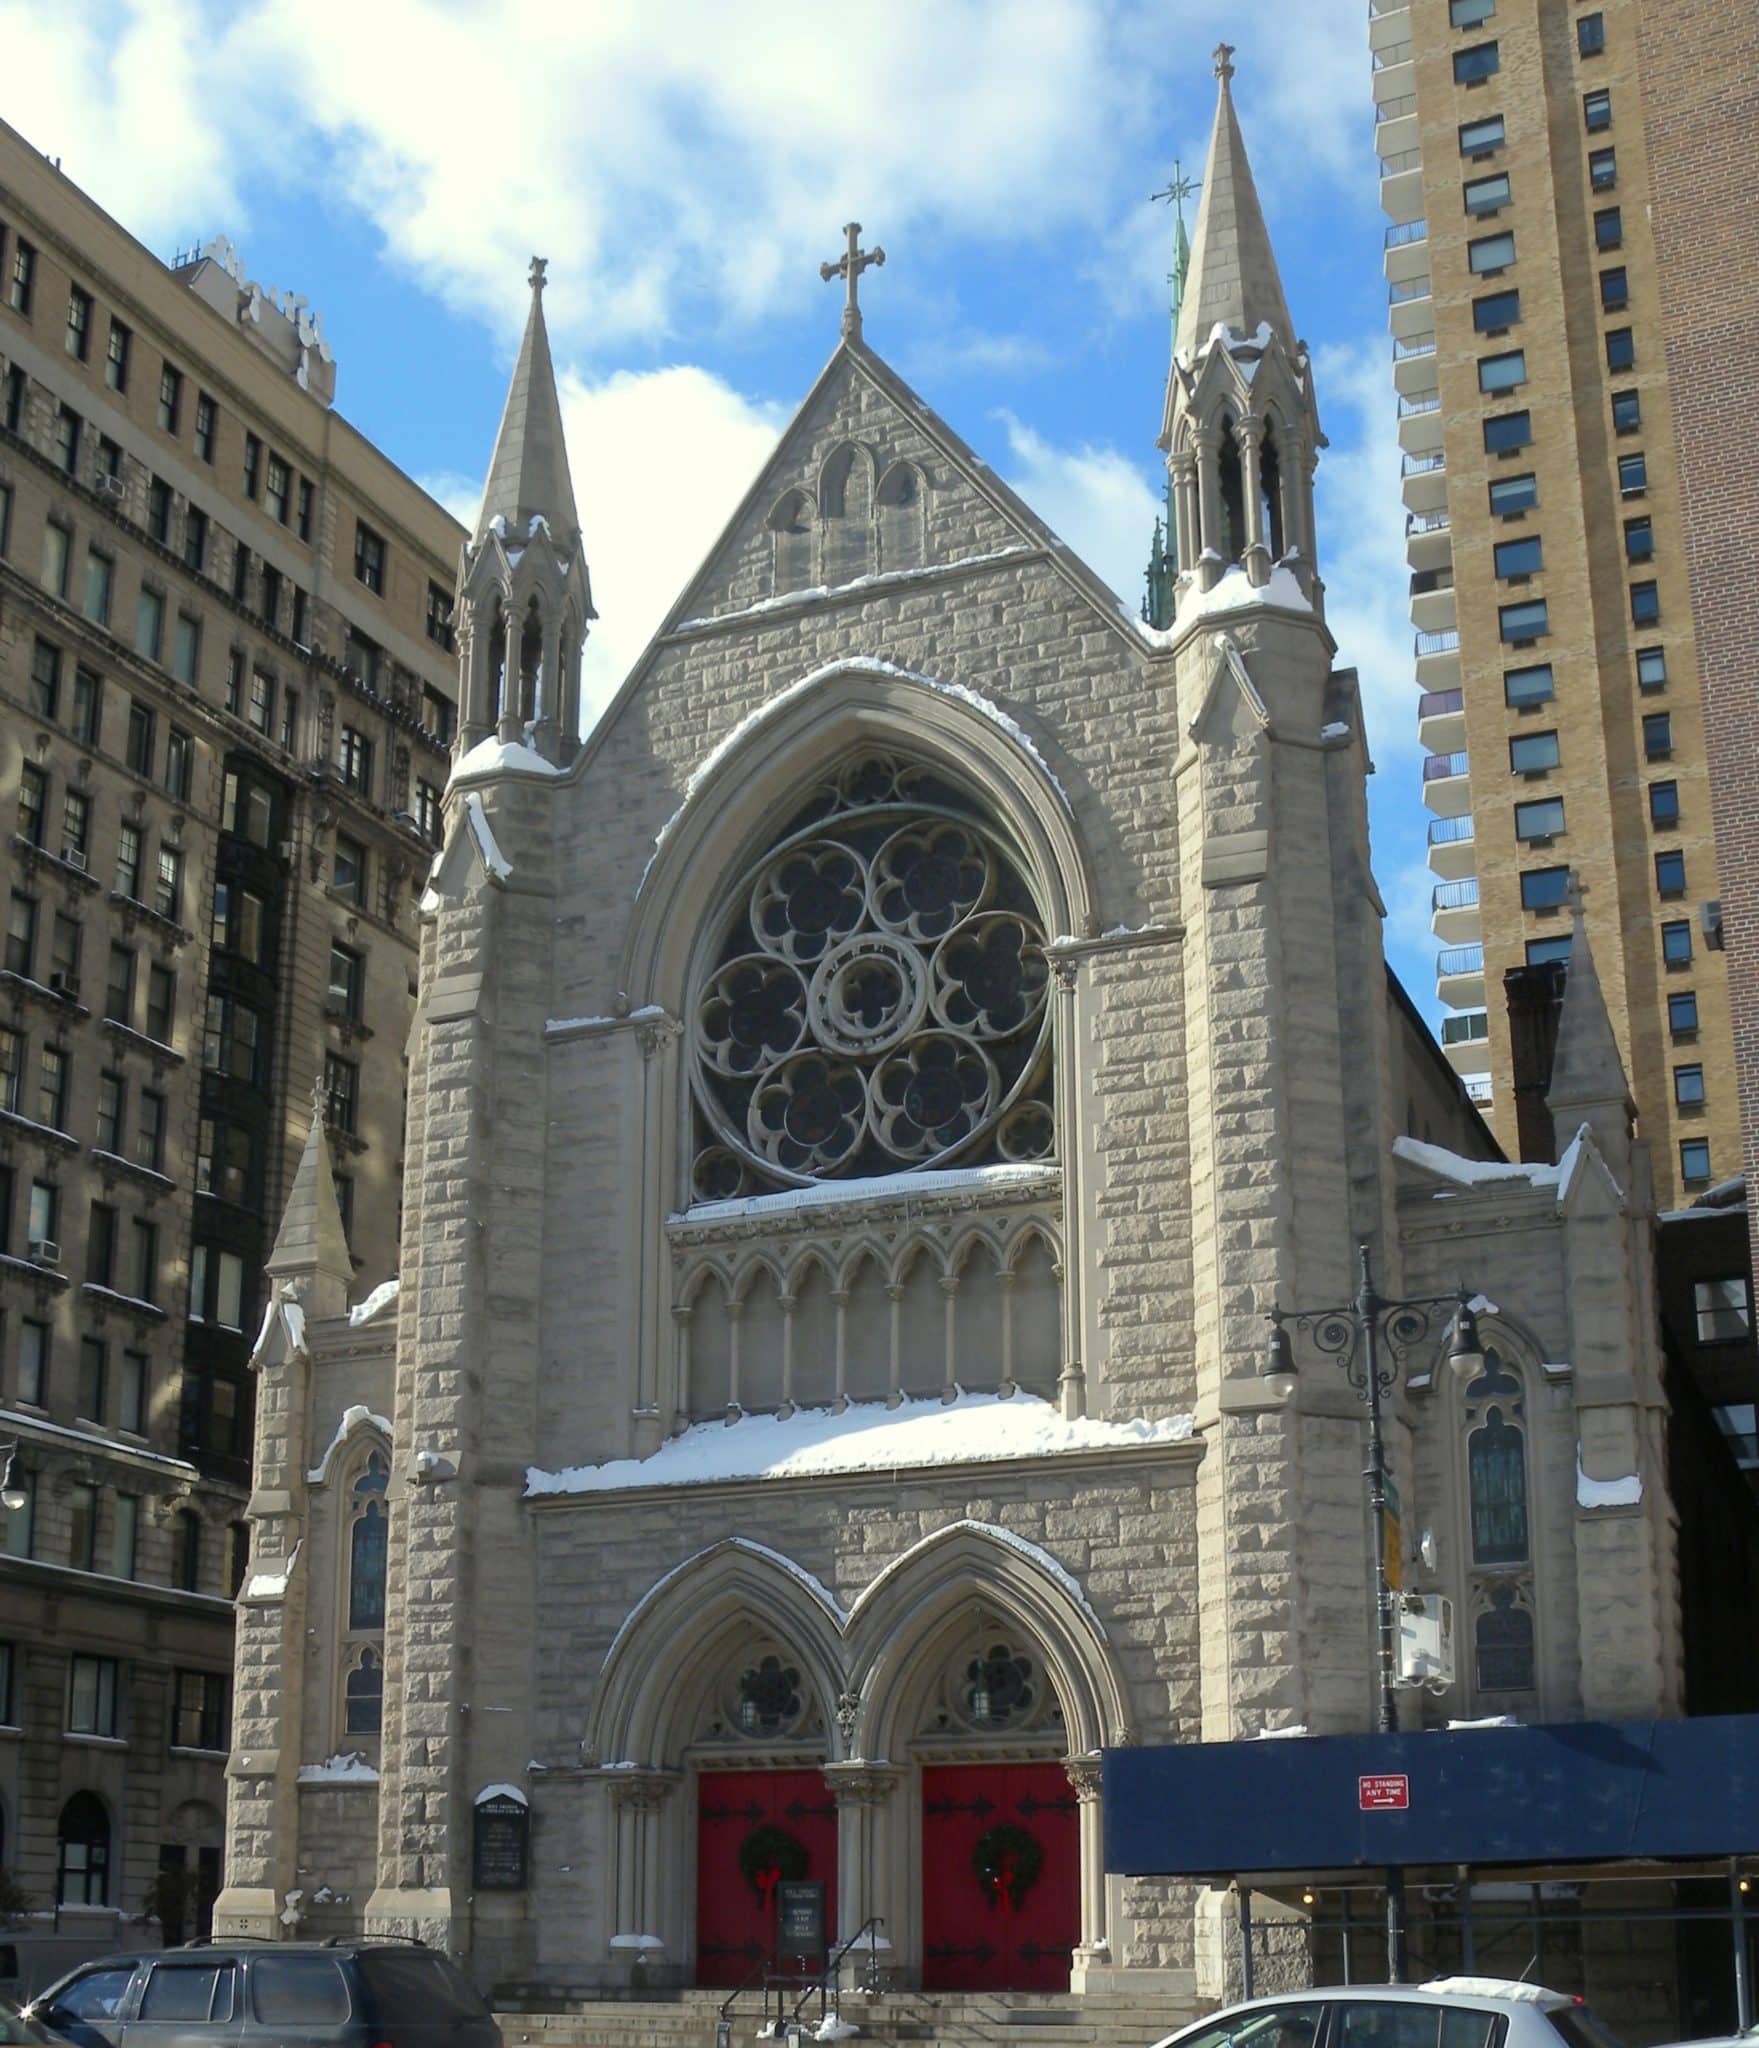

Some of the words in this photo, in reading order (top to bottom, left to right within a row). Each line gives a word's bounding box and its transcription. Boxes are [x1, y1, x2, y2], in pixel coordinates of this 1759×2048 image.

[1375, 1780, 1405, 1788] STANDING
[1366, 1789, 1381, 1797] ANY
[1386, 1788, 1401, 1796] TIME
